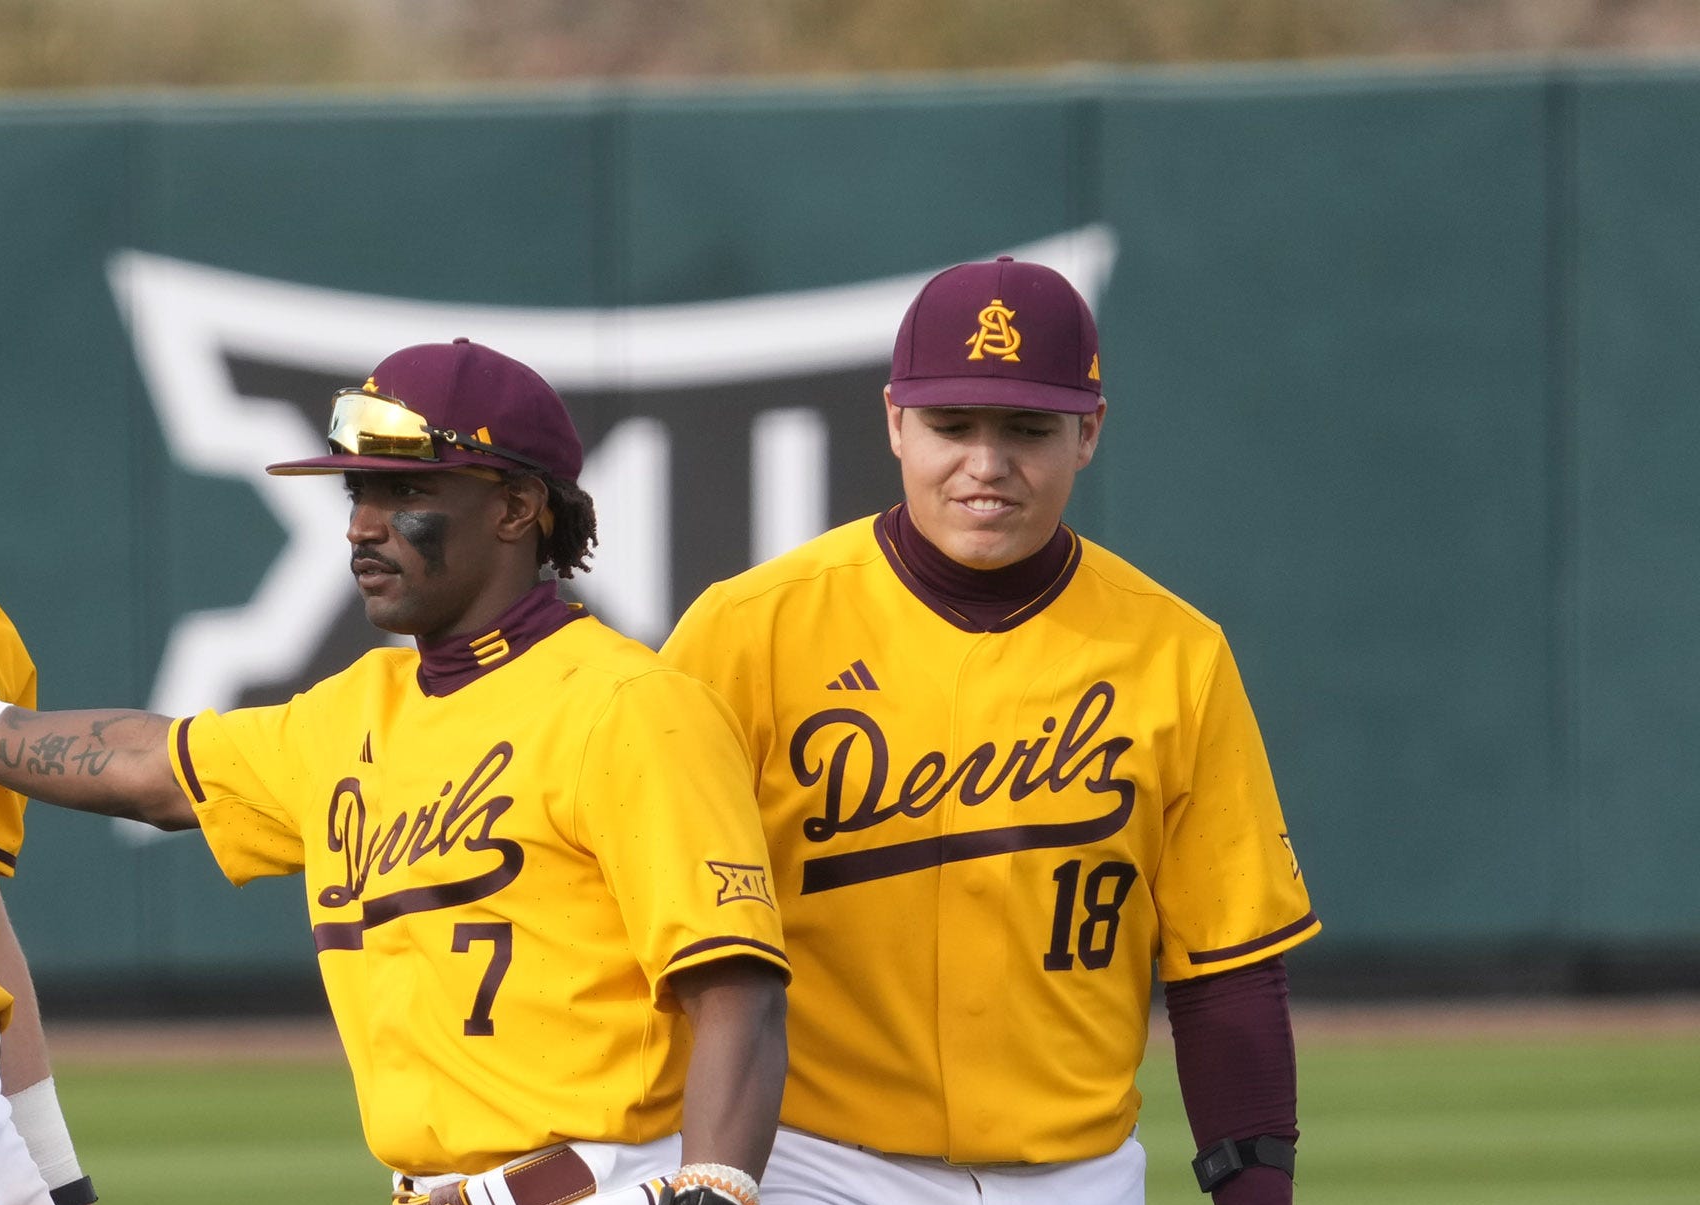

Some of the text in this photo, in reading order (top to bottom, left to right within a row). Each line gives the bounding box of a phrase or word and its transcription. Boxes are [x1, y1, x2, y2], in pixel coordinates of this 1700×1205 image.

[318, 741, 525, 908] Dvils
[790, 681, 1136, 843] Devils
[451, 922, 513, 1037] 7
[1044, 859, 1138, 972] 18
